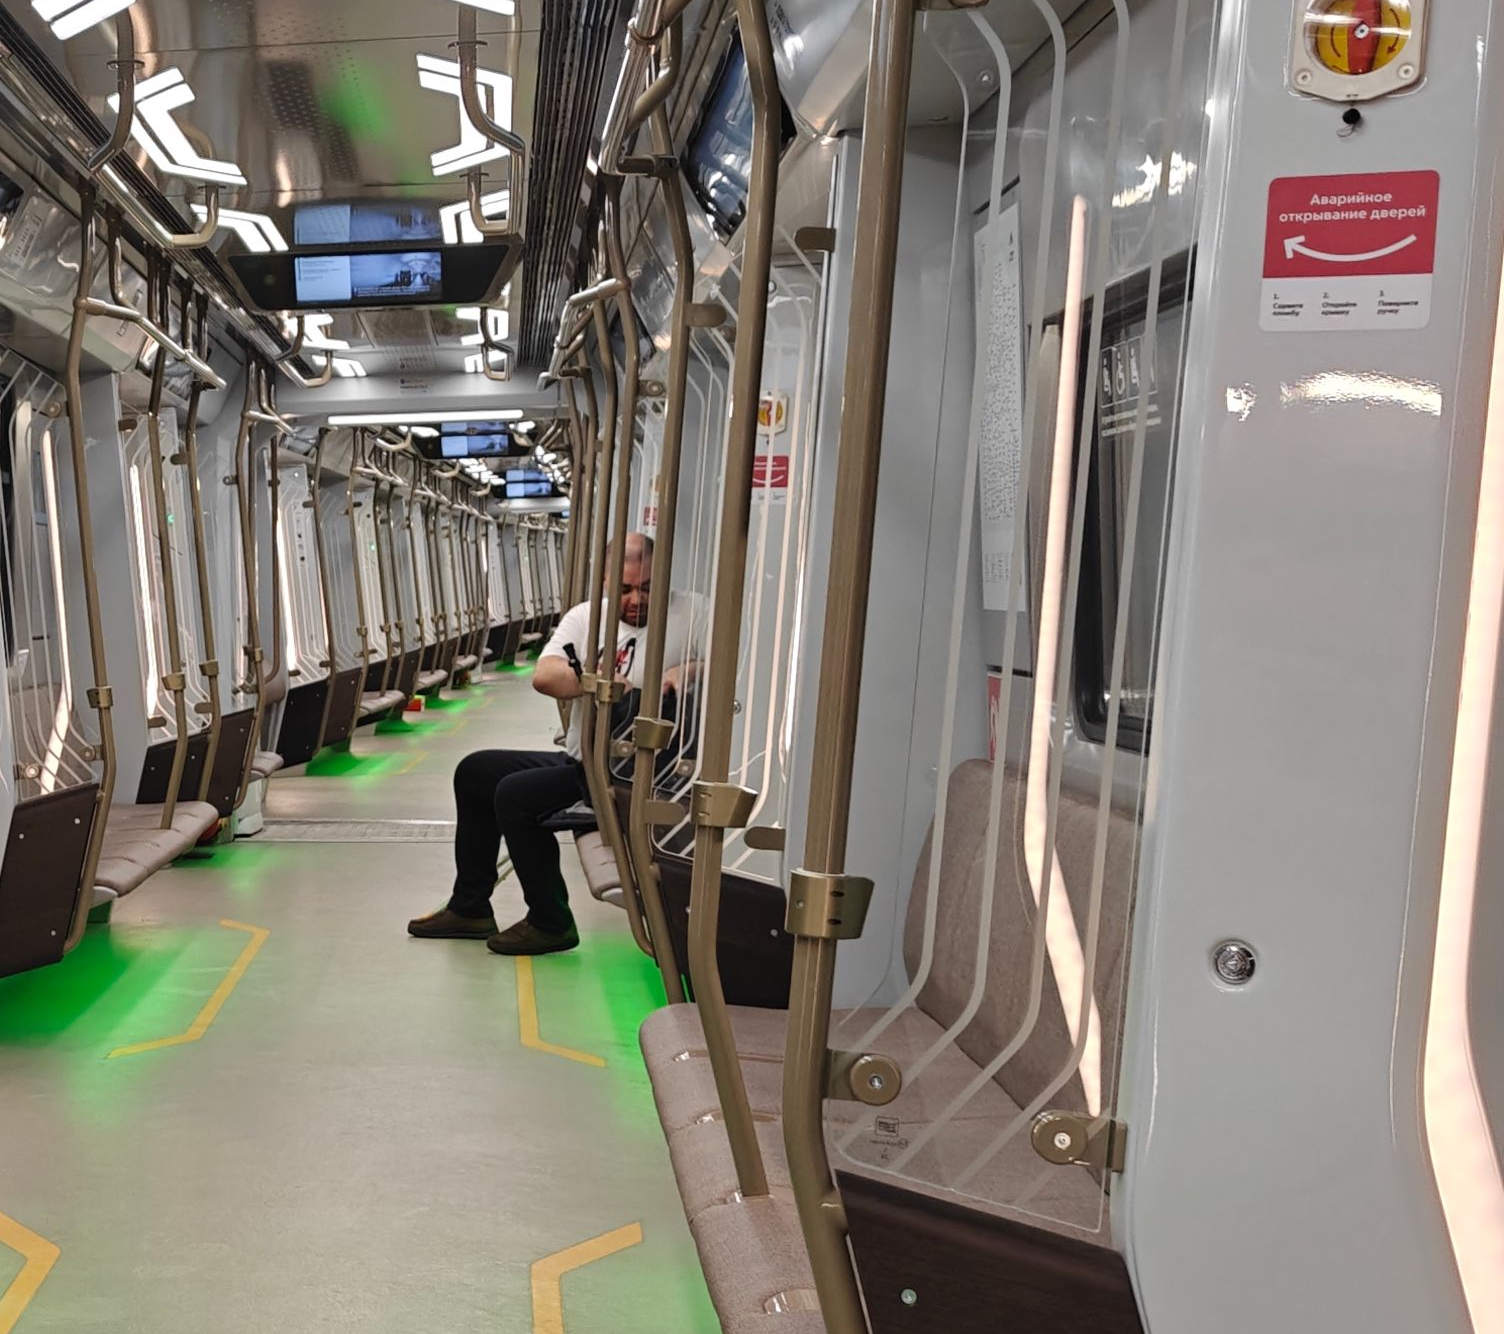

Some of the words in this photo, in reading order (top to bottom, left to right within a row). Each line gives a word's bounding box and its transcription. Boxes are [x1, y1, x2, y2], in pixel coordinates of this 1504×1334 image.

[1310, 192, 1392, 207] Аварийное
[1279, 209, 1367, 223] открывание
[1370, 205, 1426, 220] дверей
